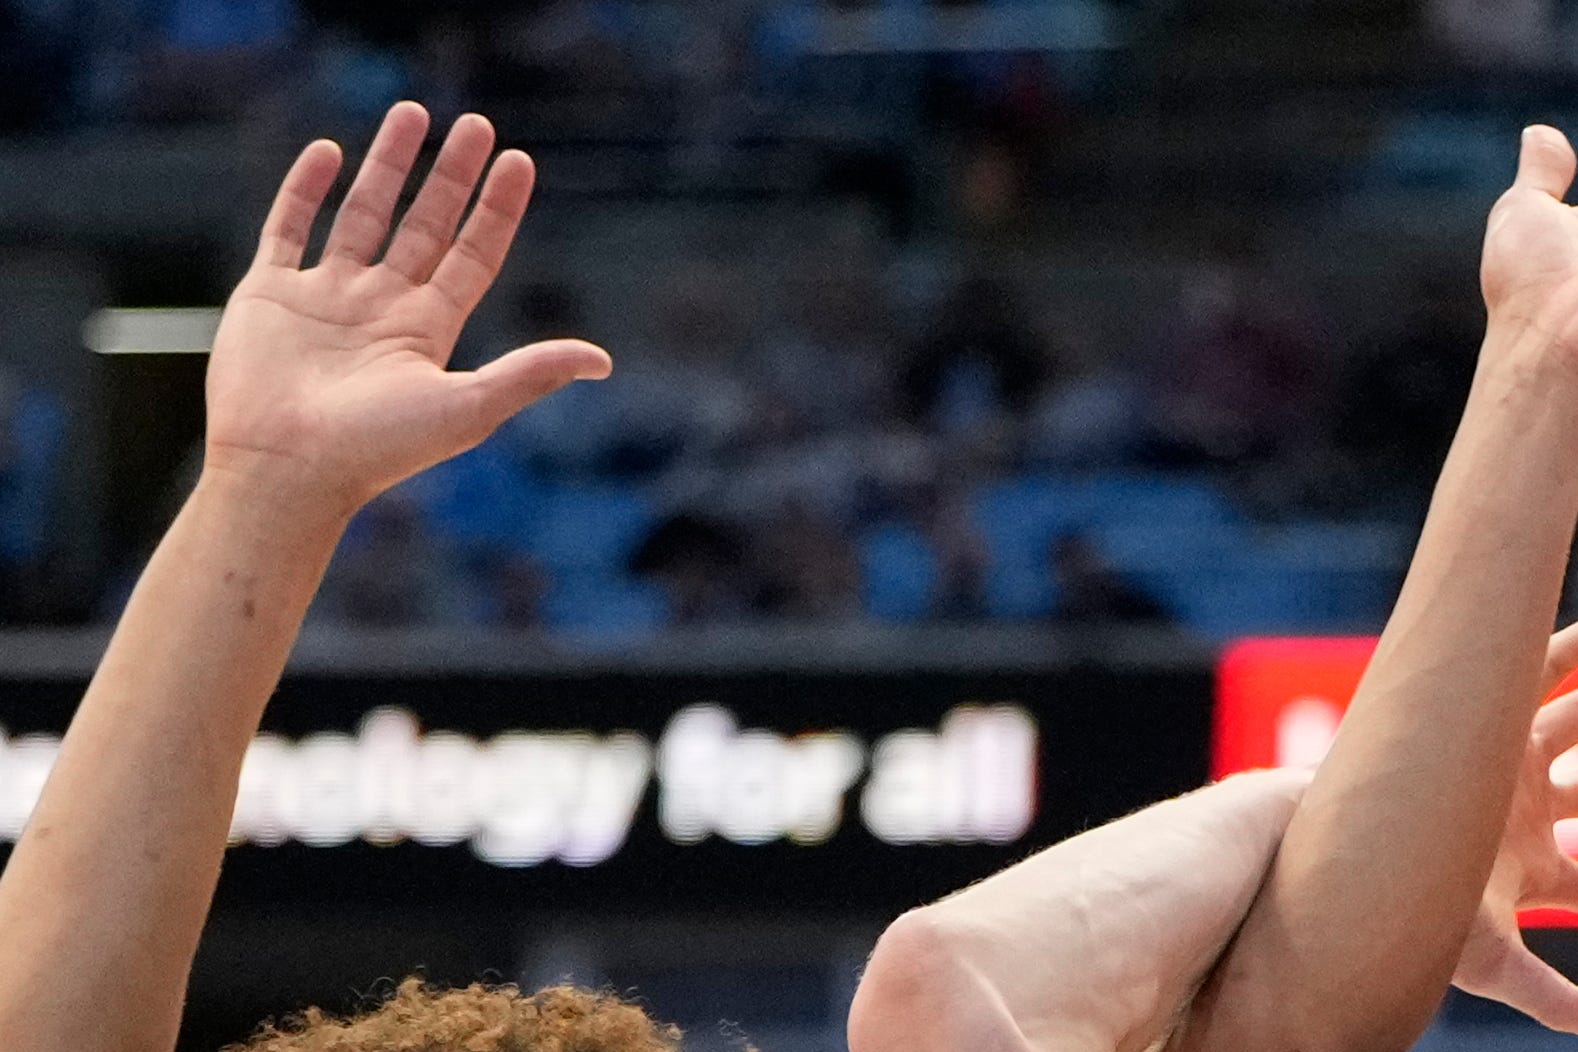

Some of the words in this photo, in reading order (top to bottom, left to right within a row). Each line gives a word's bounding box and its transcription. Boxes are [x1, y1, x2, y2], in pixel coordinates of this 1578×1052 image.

[0, 705, 650, 866] enology
[659, 703, 864, 845] for
[860, 704, 1038, 844] all
